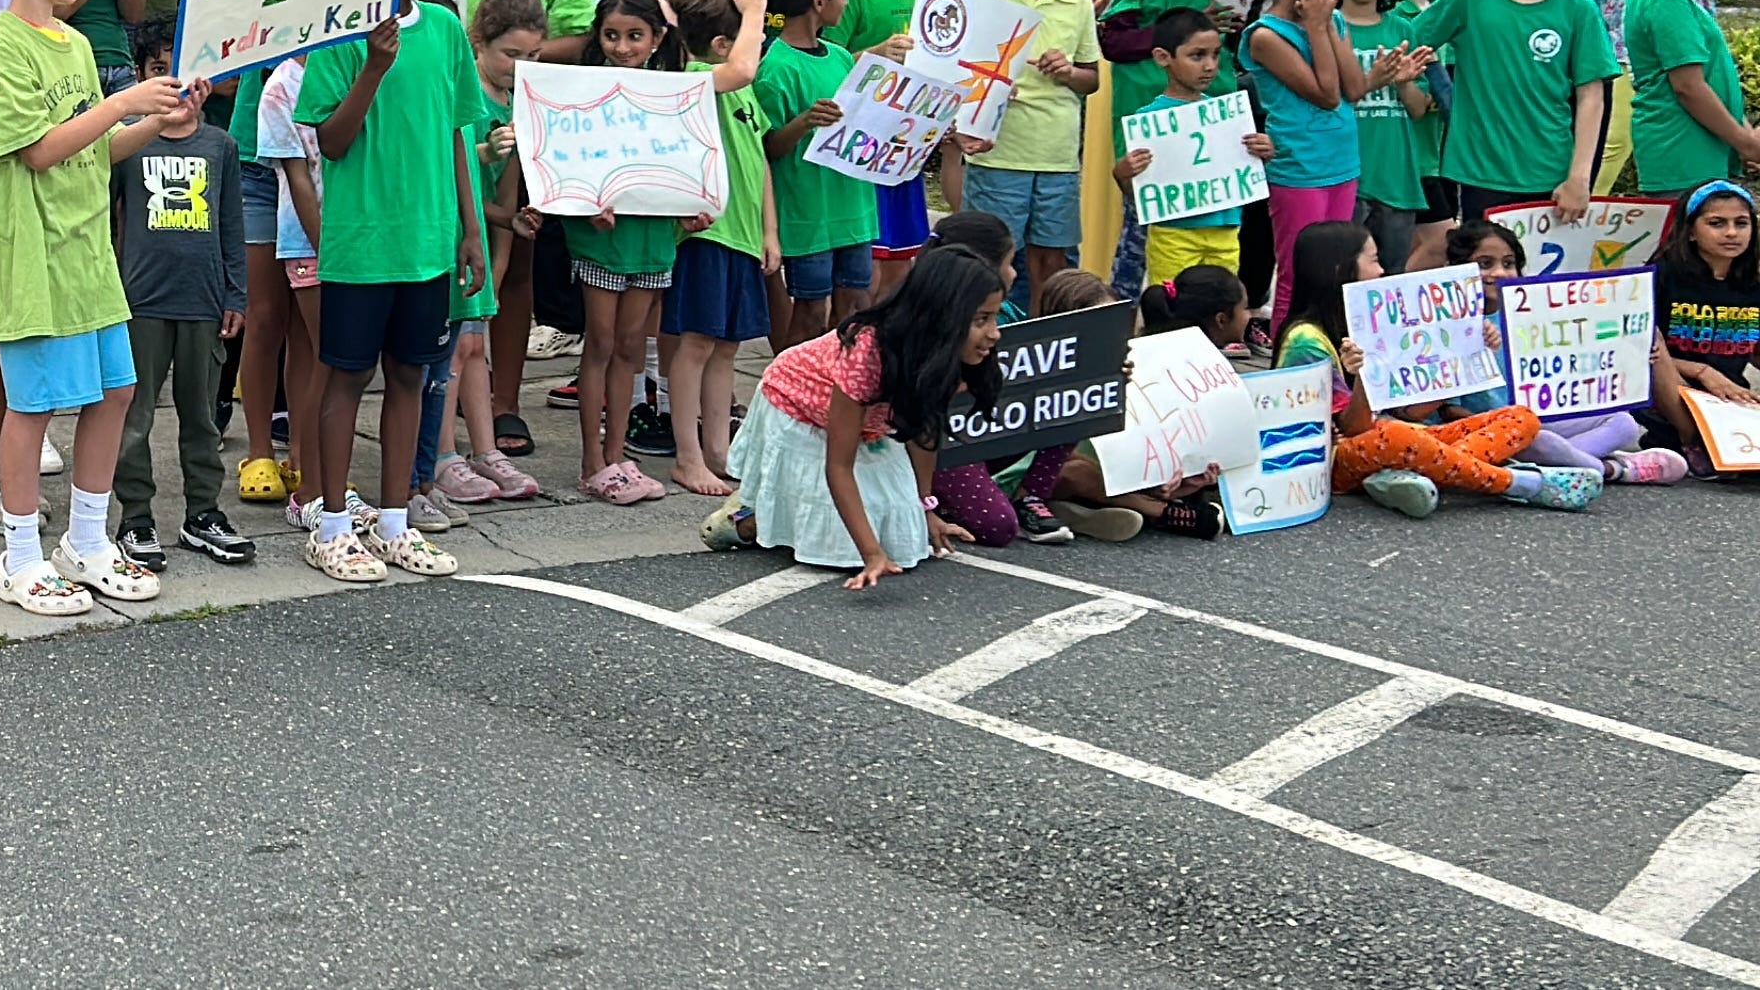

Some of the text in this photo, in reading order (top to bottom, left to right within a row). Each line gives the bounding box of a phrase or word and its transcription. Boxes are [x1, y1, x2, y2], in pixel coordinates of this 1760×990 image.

[188, 0, 382, 71] Ardrey Kell
[546, 108, 593, 136] Polo
[890, 117, 916, 145] 2
[1126, 93, 1246, 141] POLO RIDGE
[1189, 131, 1211, 166] 2
[142, 155, 208, 180] UNDER
[1138, 175, 1233, 223] ARDREY
[147, 208, 211, 232] ARMOUR
[1539, 242, 1565, 275] 2
[1514, 278, 1640, 312] 2 LEGIT 2
[1412, 329, 1441, 365] 2
[1516, 317, 1588, 354] SPLIT
[1622, 311, 1650, 337] KEEP
[996, 336, 1078, 381] SAVE
[1519, 350, 1615, 382] POLO RIDGE
[1389, 357, 1461, 398] ARDREY
[1518, 372, 1626, 410] TOGETHER
[947, 380, 1120, 442] POLO RIDGE
[1244, 471, 1329, 518] 2 MUC
